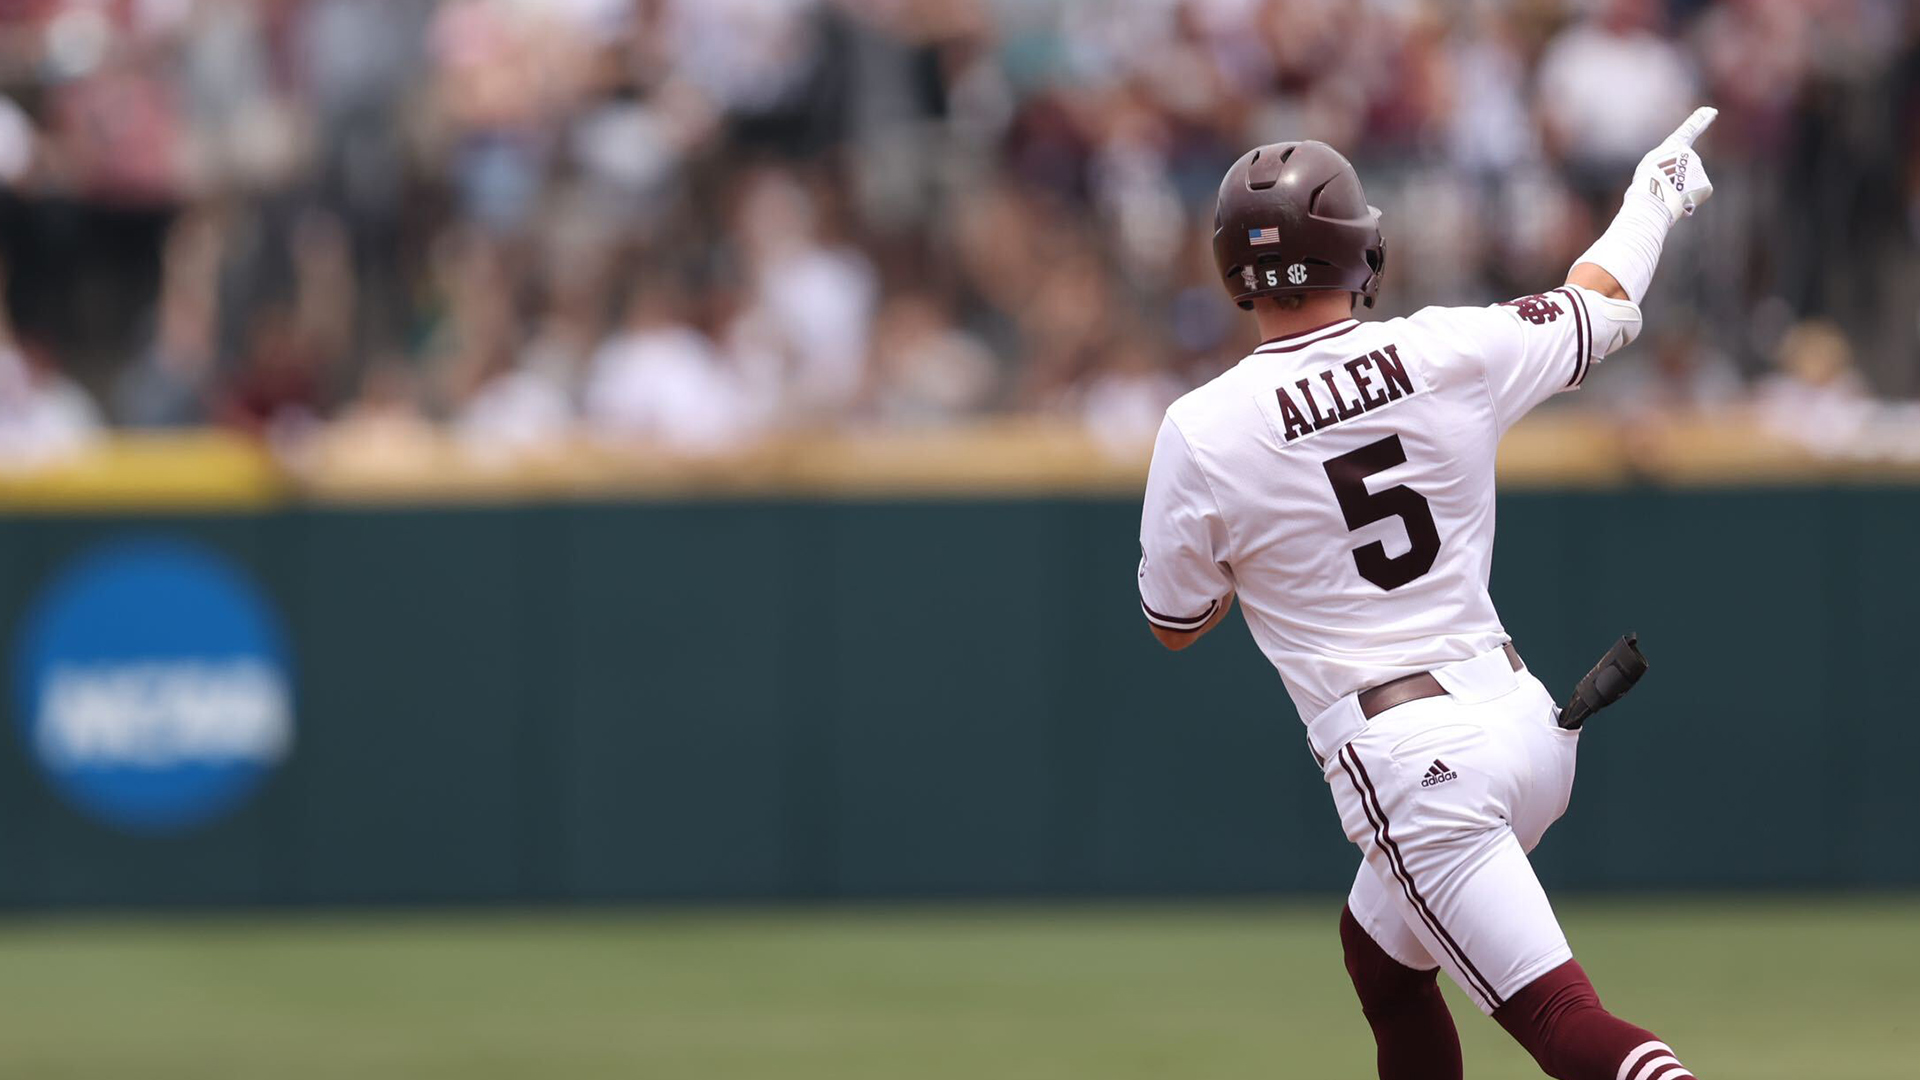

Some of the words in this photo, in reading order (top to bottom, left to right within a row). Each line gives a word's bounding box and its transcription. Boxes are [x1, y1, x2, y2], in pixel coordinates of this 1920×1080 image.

[1676, 153, 1689, 192] adidas
[1265, 270, 1278, 287] 5
[1287, 263, 1308, 285] SEC
[1275, 343, 1415, 442] ALLEN
[1322, 433, 1441, 592] 5
[1421, 771, 1458, 787] adidas
